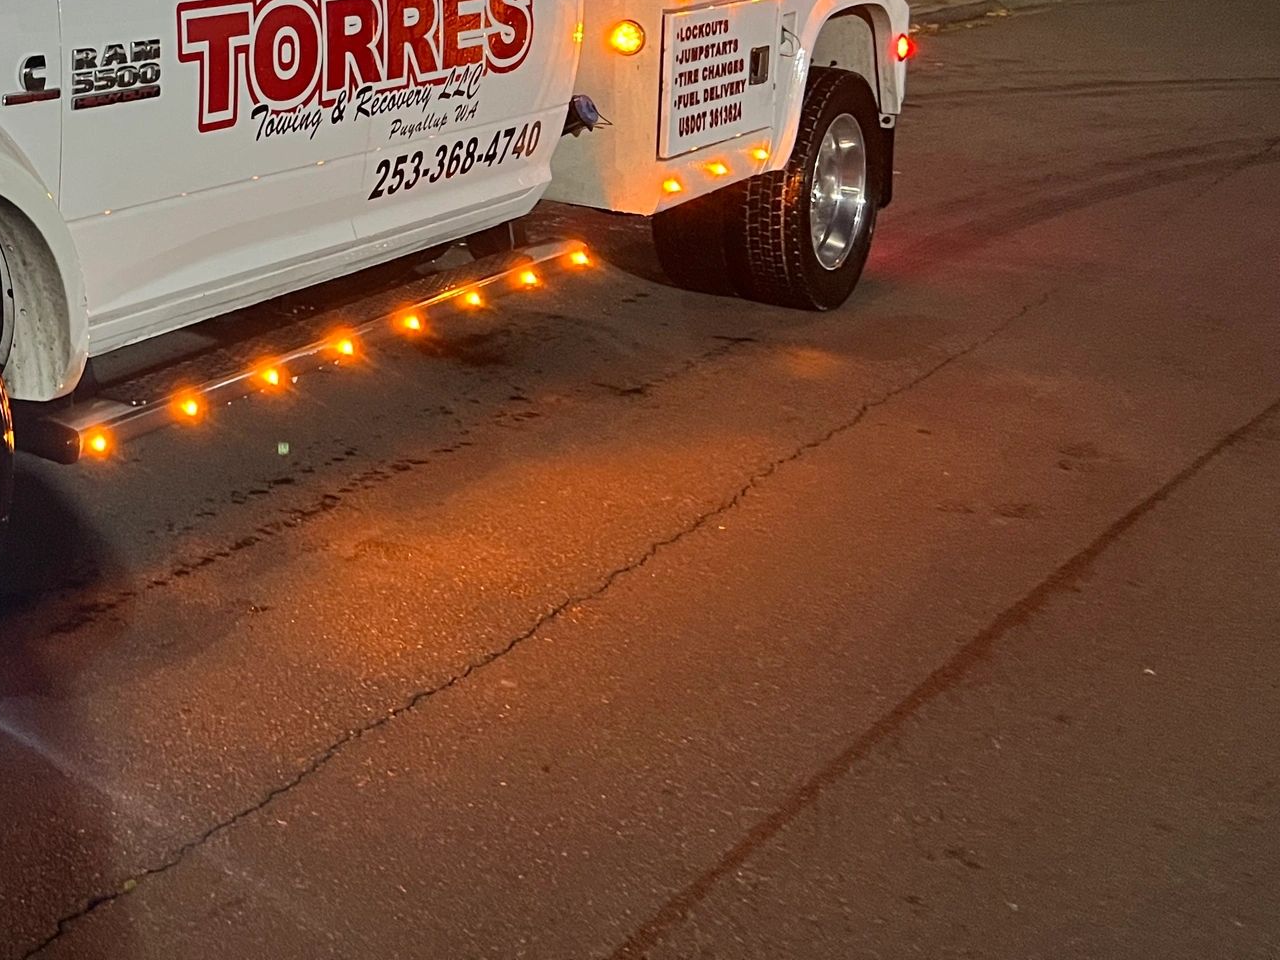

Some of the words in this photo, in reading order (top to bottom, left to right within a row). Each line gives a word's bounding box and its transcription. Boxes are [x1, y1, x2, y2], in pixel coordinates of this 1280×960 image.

[680, 20, 729, 42] LOCKOUTS
[71, 39, 161, 71] RAM
[679, 39, 738, 64] JUMPSTARTS
[71, 63, 161, 95] 5500
[678, 68, 699, 87] TIRE
[702, 58, 744, 81] CHANGES
[250, 104, 323, 141] Towing
[331, 90, 346, 124] &
[354, 83, 434, 122] Recovery
[437, 63, 484, 101] LLC
[677, 91, 700, 110] FUEL
[703, 78, 747, 103] DELIVERY
[389, 112, 447, 139] Puyallup
[455, 100, 478, 122] WA
[679, 111, 707, 137] USDOT
[367, 120, 542, 200] 253-368-4740
